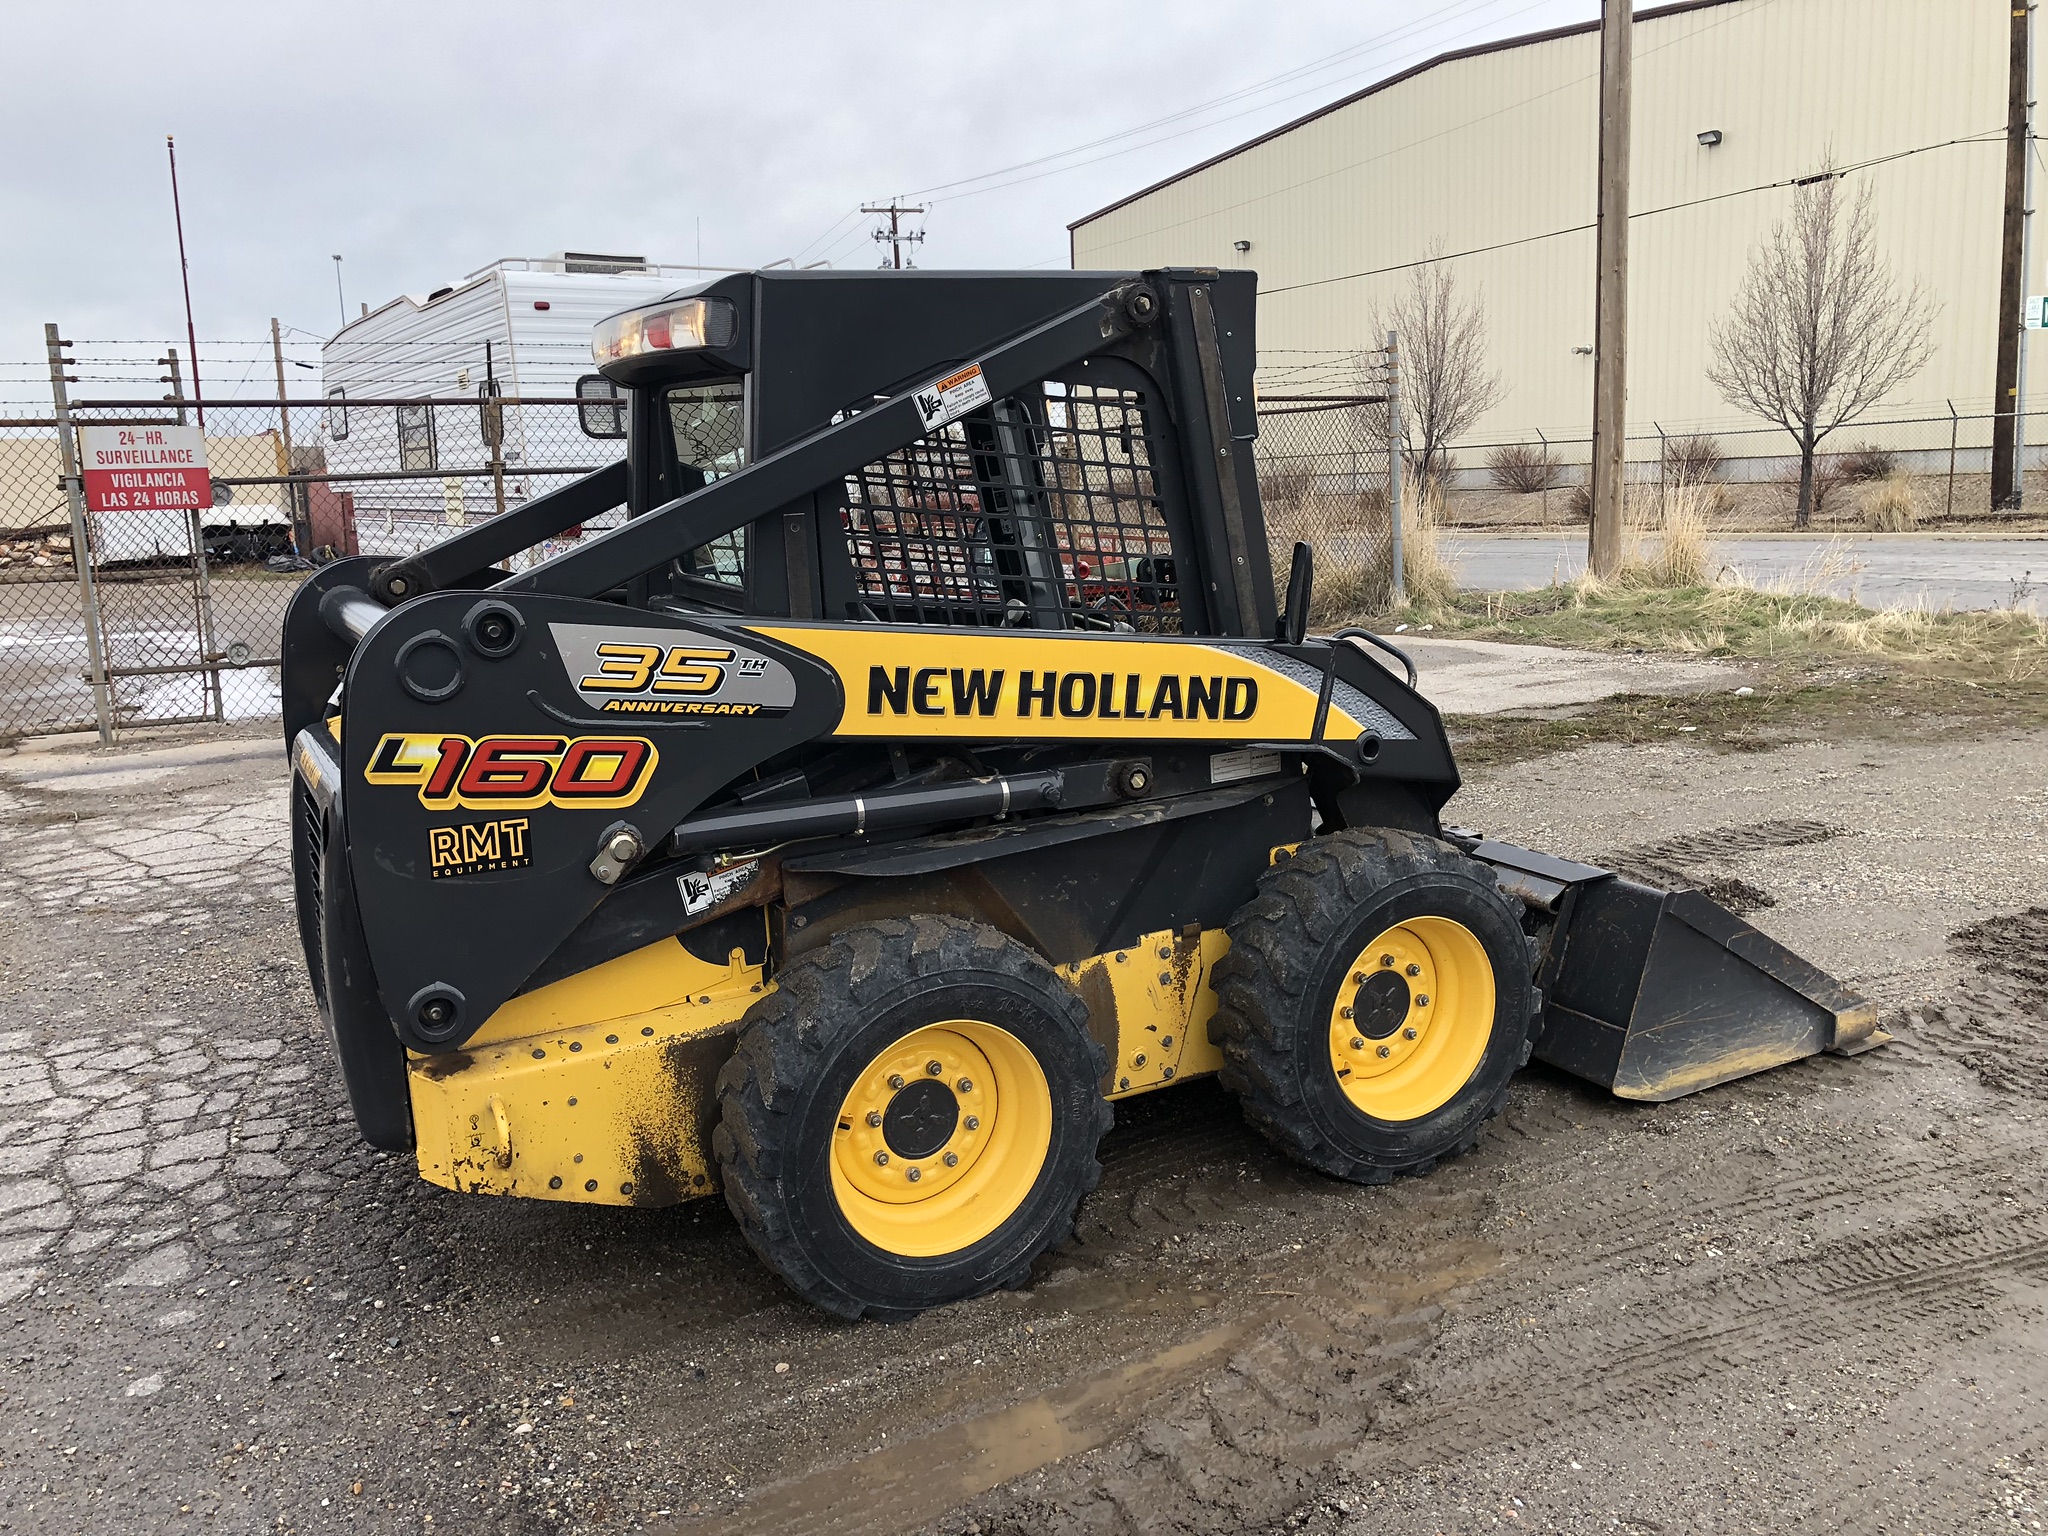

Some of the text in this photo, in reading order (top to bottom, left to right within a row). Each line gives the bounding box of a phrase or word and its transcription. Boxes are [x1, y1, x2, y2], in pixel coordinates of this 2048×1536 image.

[948, 368, 977, 386] WARNING
[949, 380, 975, 395] PINCH AREA
[119, 431, 168, 445] 24-HR.
[96, 449, 194, 465] SURVEILLANCE
[111, 472, 186, 488] VIGILANCIA
[102, 490, 199, 507] LAS 24 HORAS
[867, 665, 1259, 721] NEW HOLLAND
[603, 700, 761, 716] ANNIVERSARY
[367, 735, 656, 806] L160
[429, 817, 530, 867] RMT
[433, 858, 530, 878] EQUIPMENT
